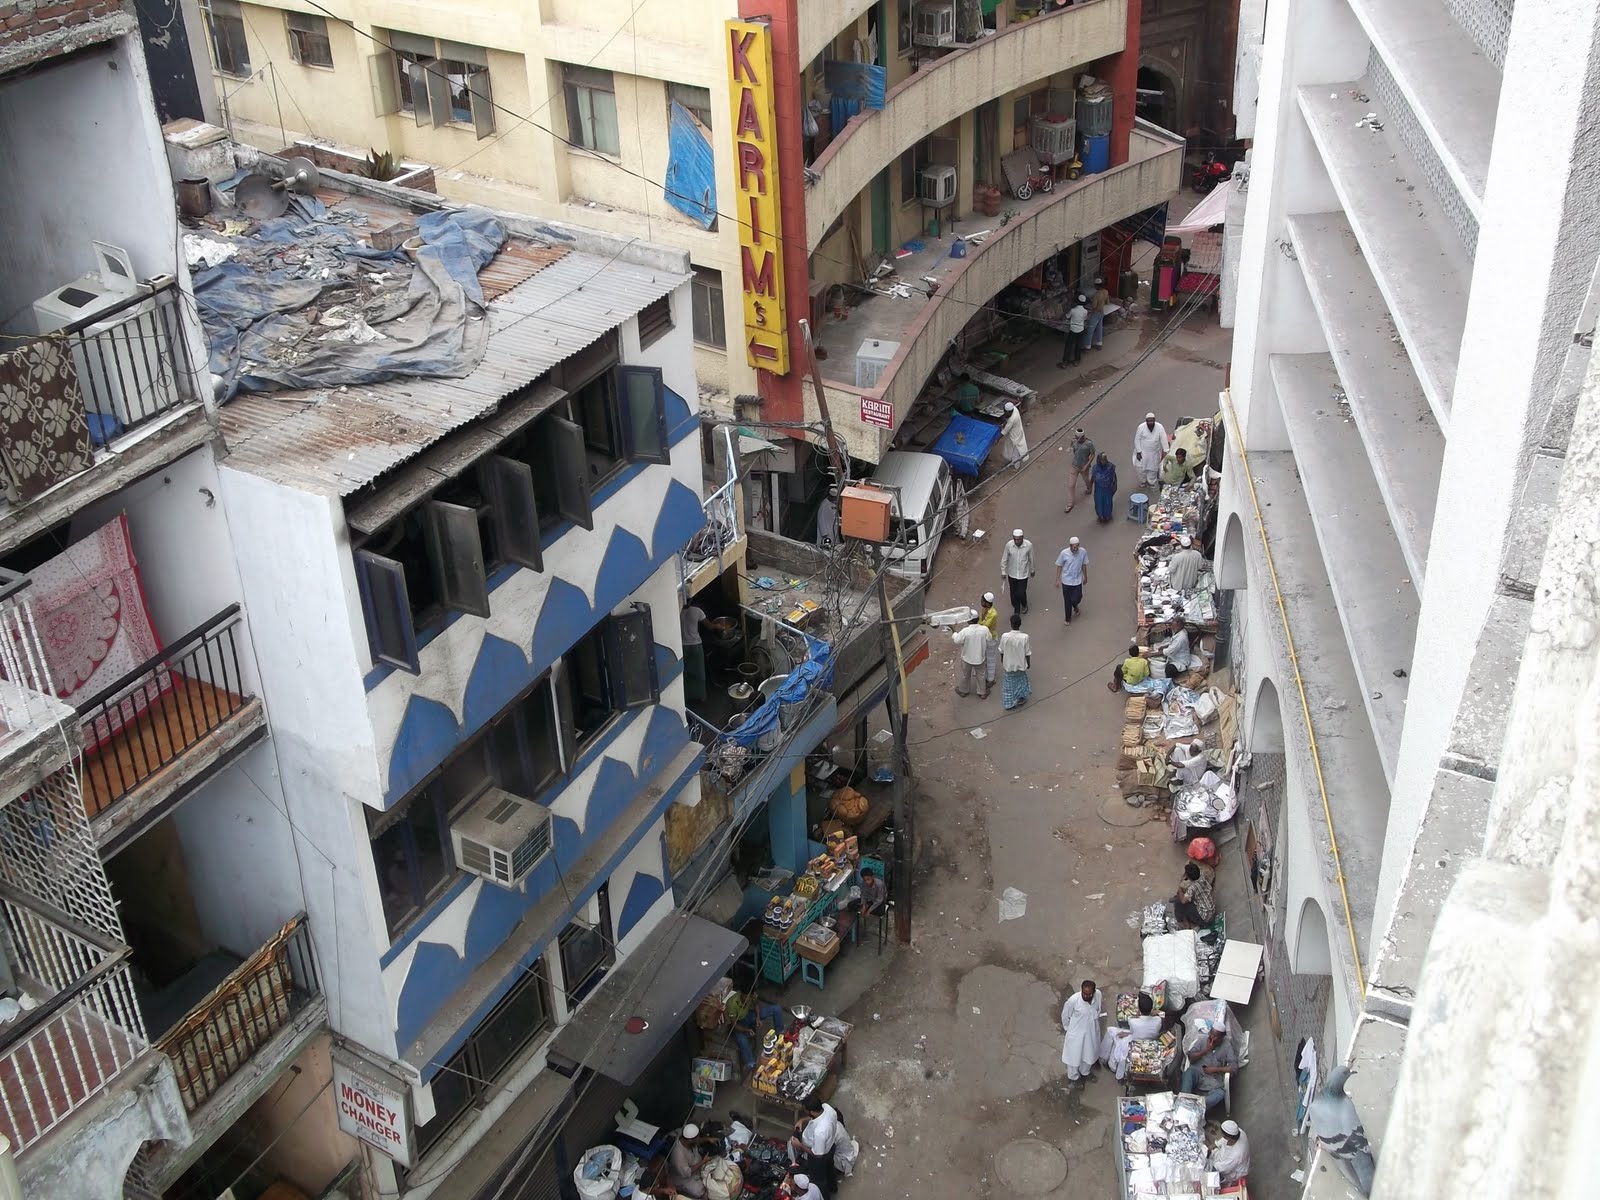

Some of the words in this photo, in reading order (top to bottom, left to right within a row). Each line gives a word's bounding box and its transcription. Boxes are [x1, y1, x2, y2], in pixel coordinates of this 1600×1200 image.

[862, 399, 891, 415] KARIM
[341, 1083, 397, 1126] MONEY
[341, 1102, 402, 1145] CHANGER
